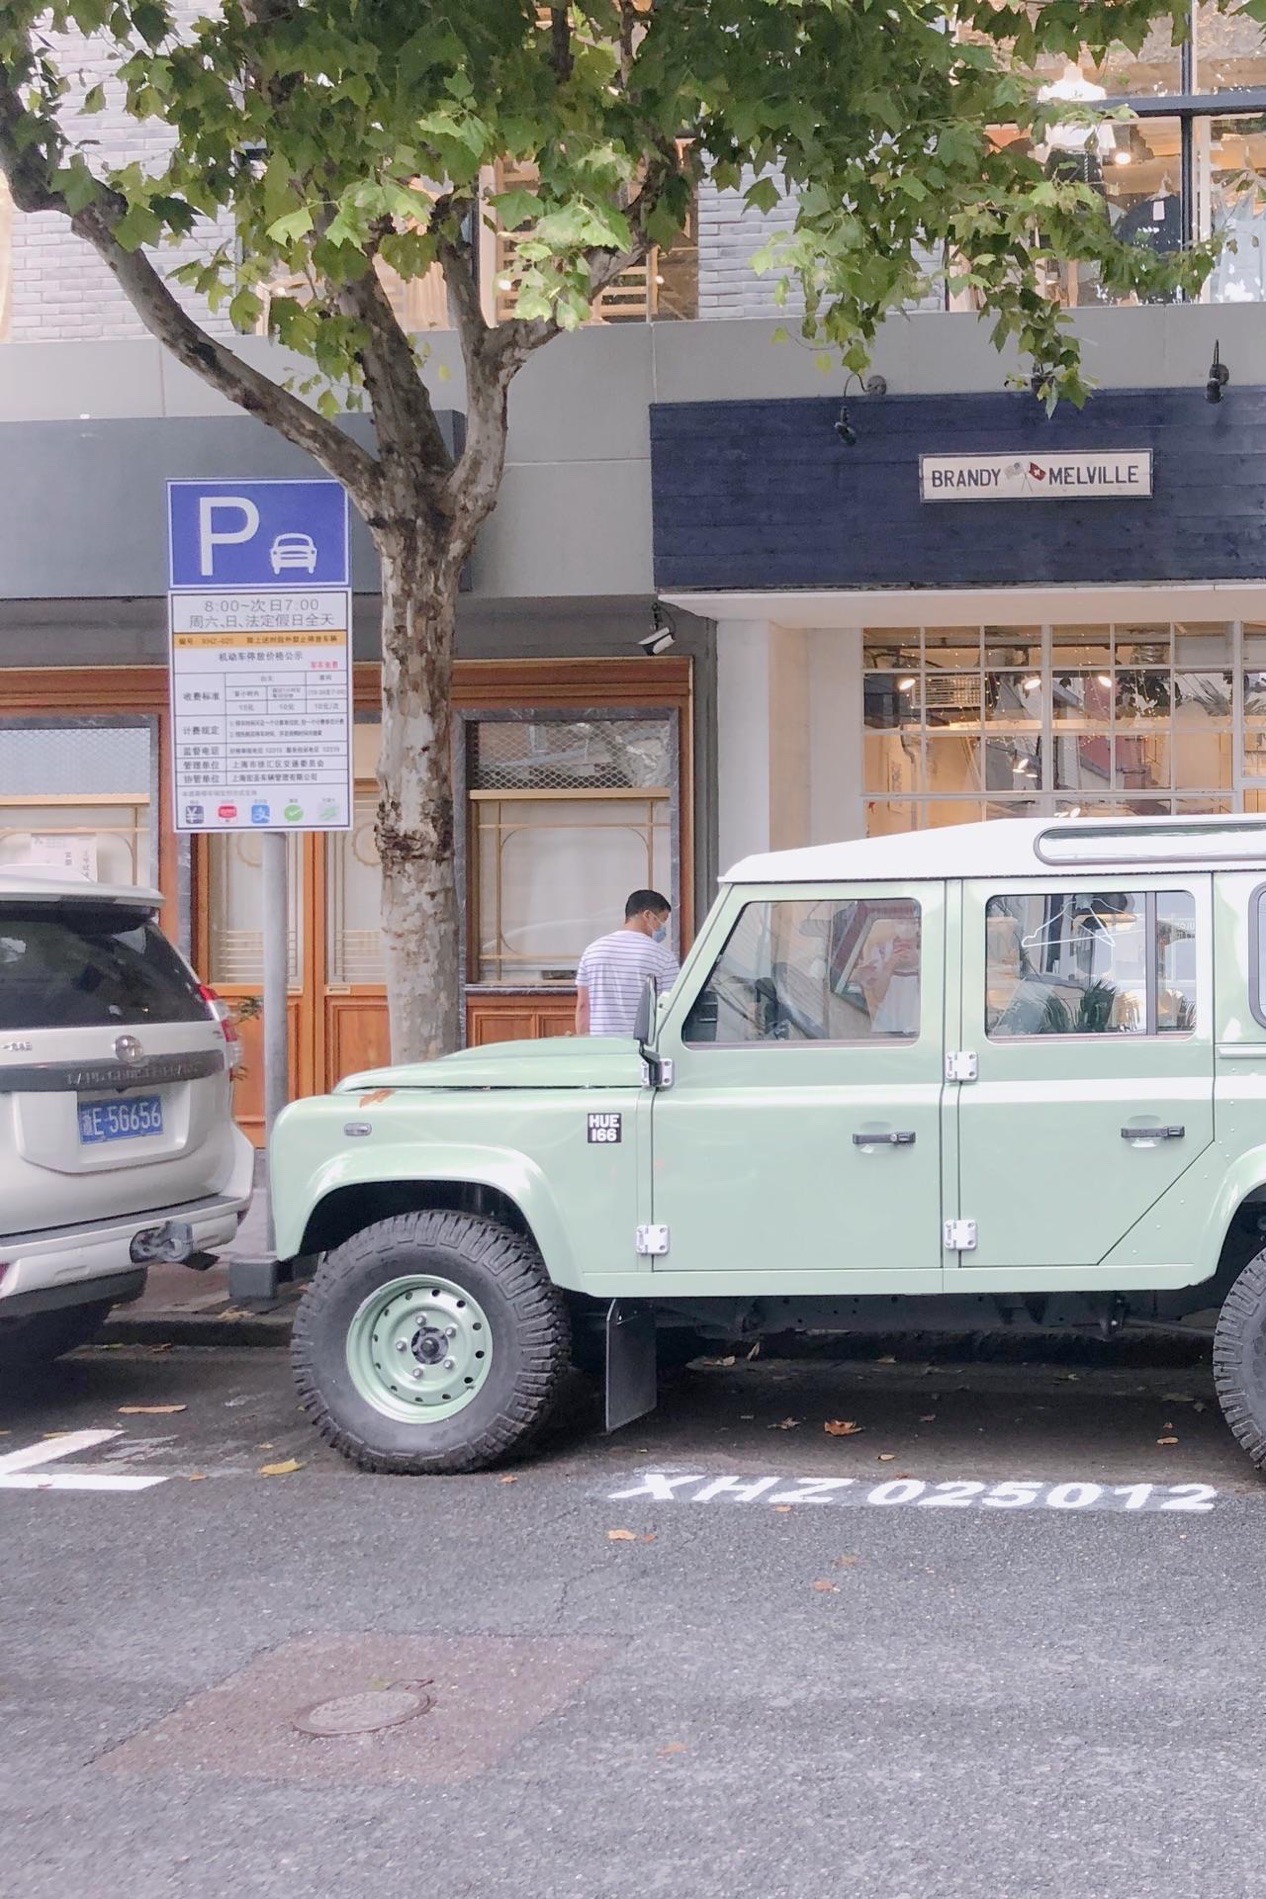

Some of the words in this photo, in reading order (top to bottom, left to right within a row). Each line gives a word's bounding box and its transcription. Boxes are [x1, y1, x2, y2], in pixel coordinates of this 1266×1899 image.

[931, 468, 1001, 488] BRANDY
[1049, 465, 1139, 486] MELVILLE
[199, 496, 260, 577] P
[588, 1114, 620, 1128] HUE
[591, 1128, 617, 1142] 166
[606, 1472, 856, 1504] XHZ
[865, 1478, 1219, 1512] 025012
